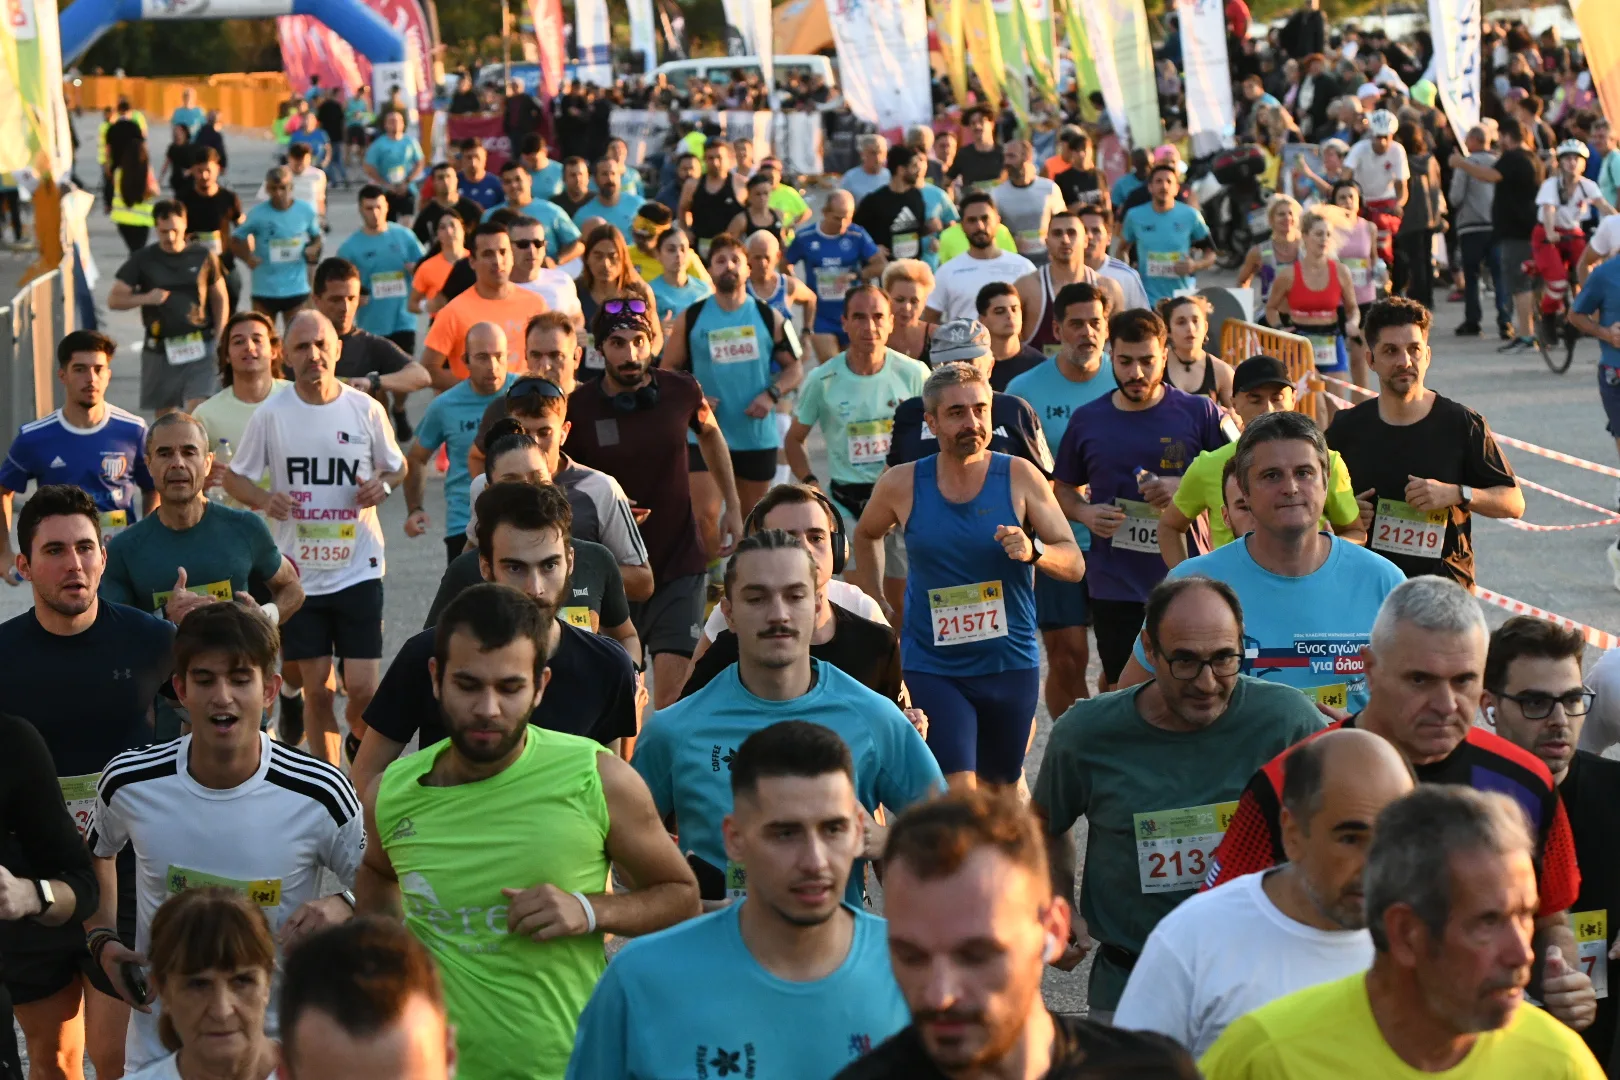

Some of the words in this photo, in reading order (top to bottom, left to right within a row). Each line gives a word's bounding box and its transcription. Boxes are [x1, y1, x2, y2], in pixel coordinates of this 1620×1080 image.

[713, 343, 753, 358] 21640
[286, 457, 359, 486] RUN
[1378, 524, 1438, 548] 21219
[300, 545, 350, 561] 21350
[938, 610, 998, 635] 21577
[1294, 642, 1326, 655] Ένας
[1311, 660, 1333, 673] για
[711, 744, 722, 772] COFFEE
